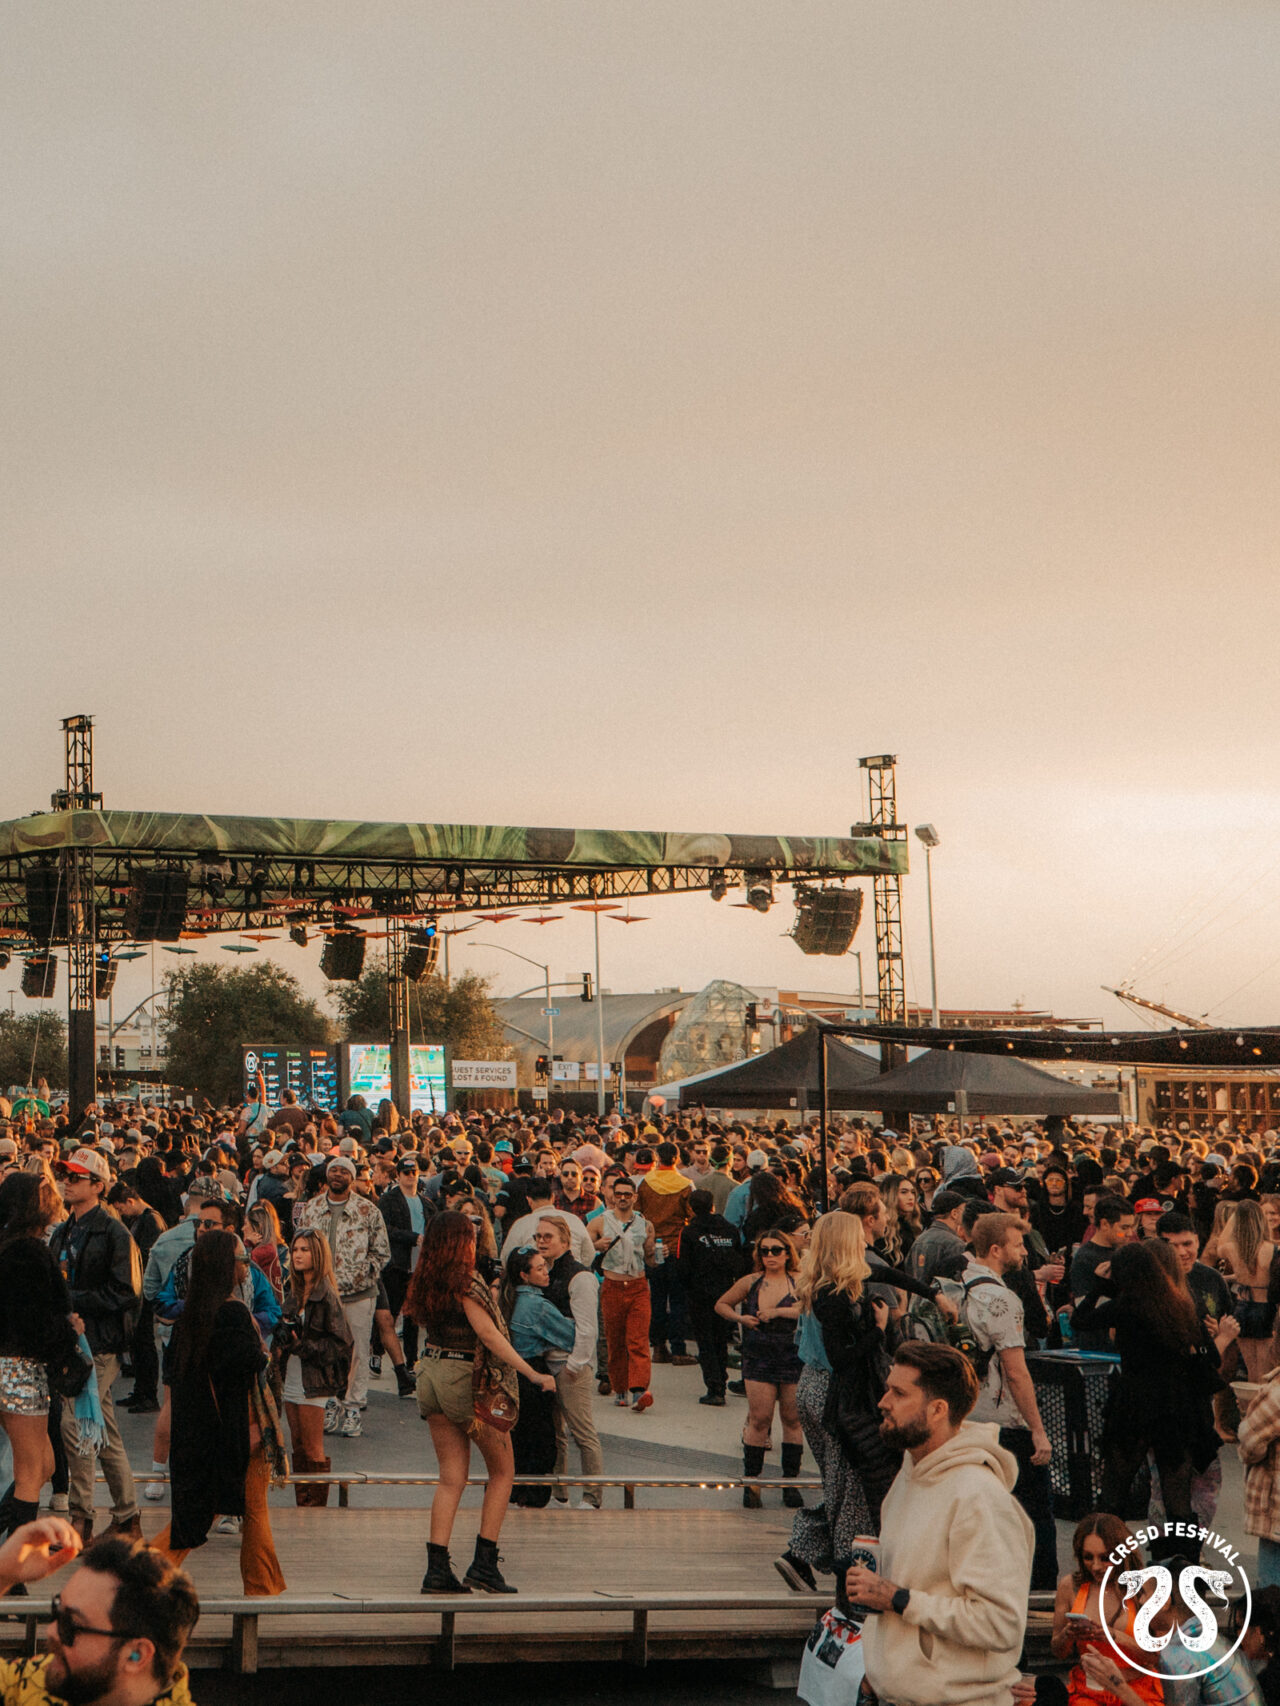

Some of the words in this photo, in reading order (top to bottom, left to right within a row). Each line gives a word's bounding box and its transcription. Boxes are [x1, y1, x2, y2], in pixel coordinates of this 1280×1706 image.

[453, 1066, 473, 1074] UEST
[475, 1067, 512, 1075] SERVICES
[558, 1063, 573, 1071] EXIT
